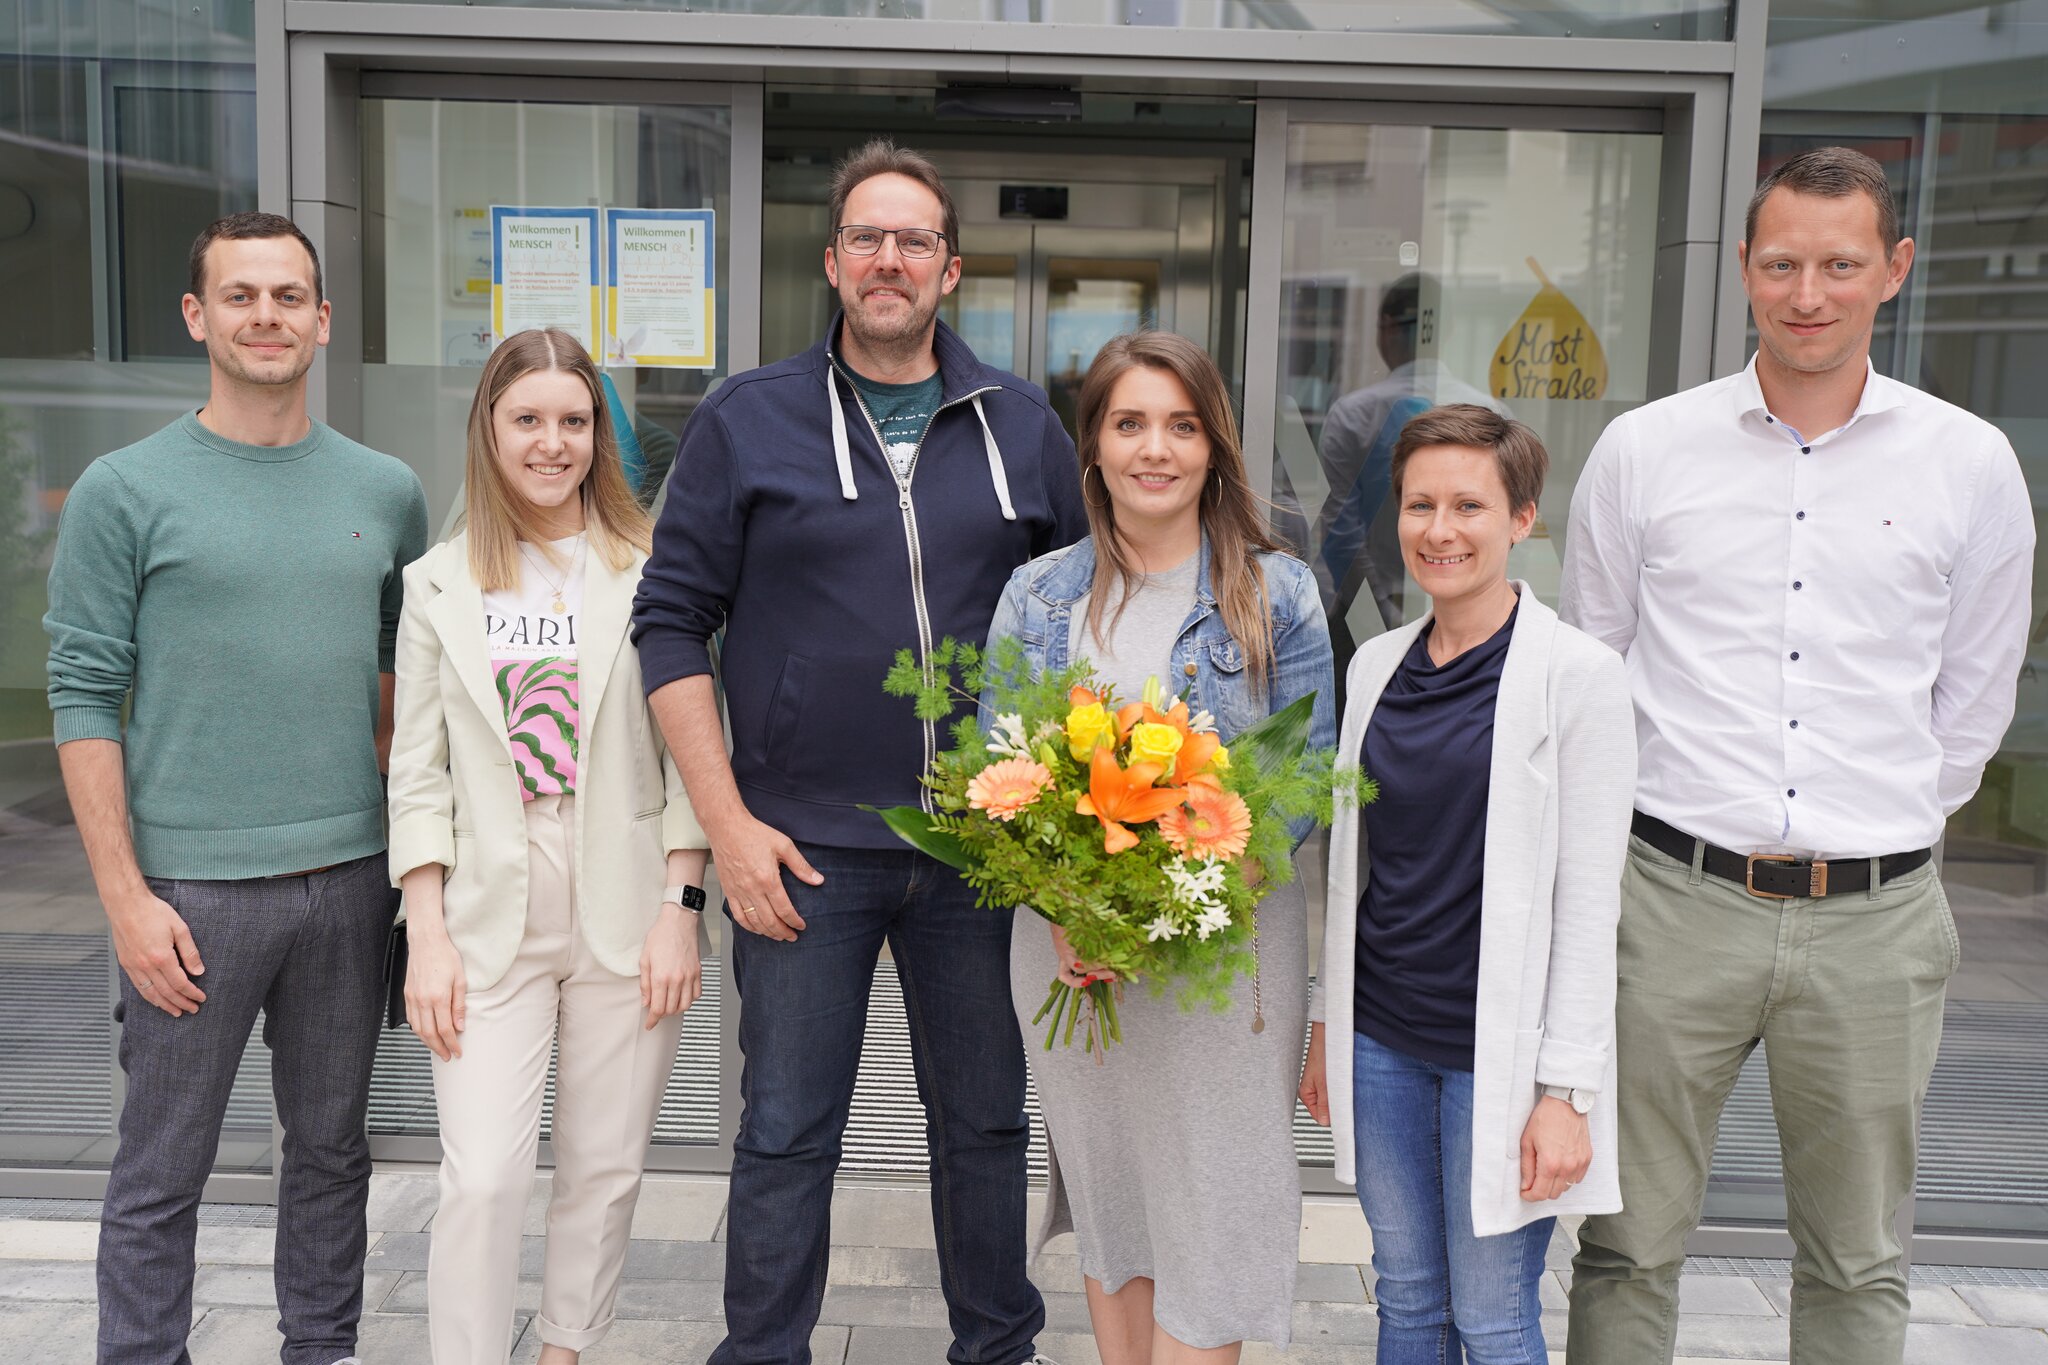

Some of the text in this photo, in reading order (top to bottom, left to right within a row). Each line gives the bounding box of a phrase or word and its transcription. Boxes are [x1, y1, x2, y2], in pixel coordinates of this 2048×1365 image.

[509, 225, 571, 235] Willkommen
[624, 227, 686, 237] Willkommen
[509, 240, 552, 249] MENSCH
[624, 243, 667, 252] MENSCH
[1500, 322, 1584, 365] Most
[1501, 359, 1596, 400] Straße
